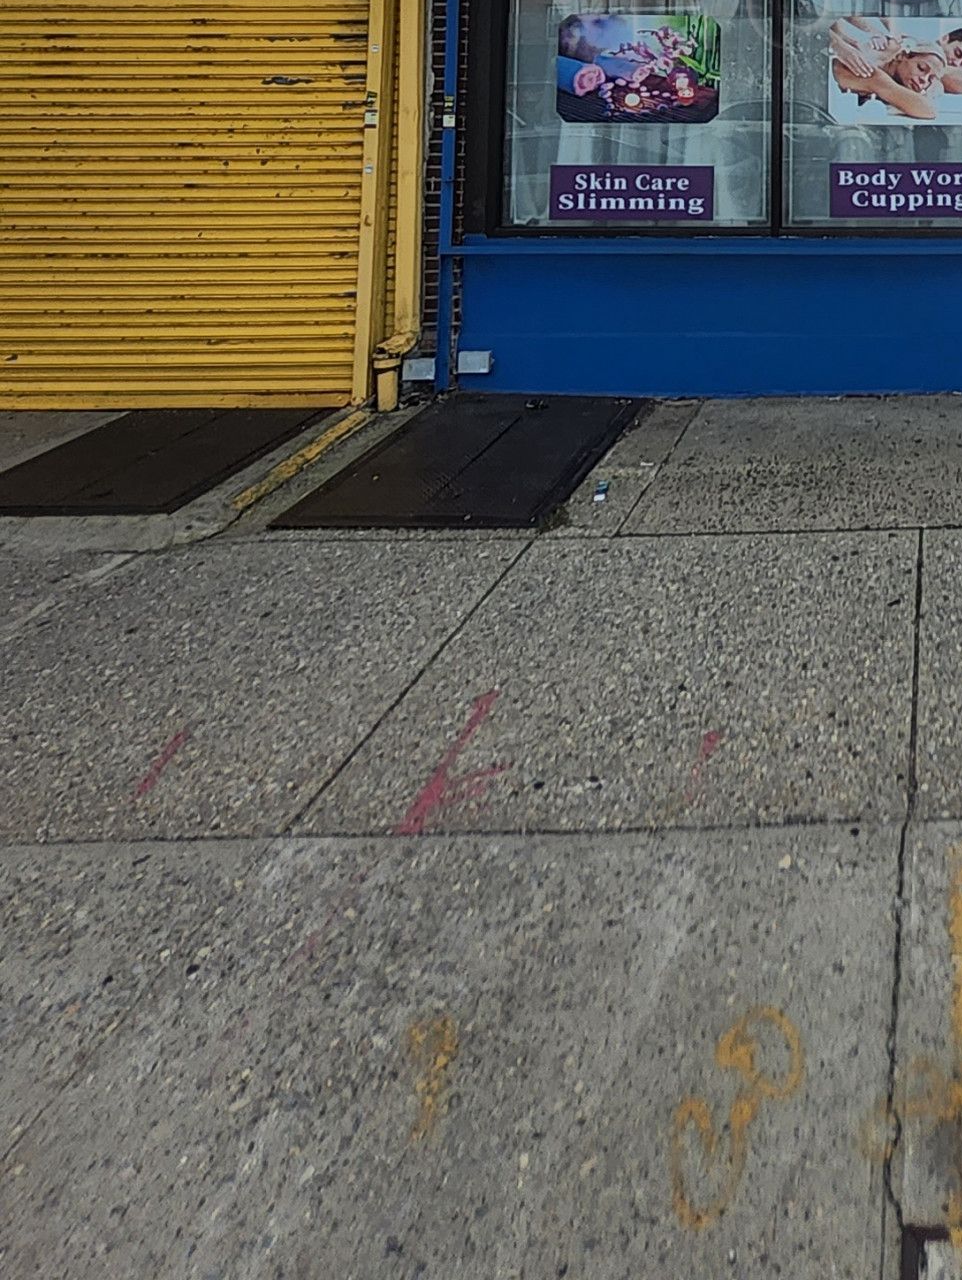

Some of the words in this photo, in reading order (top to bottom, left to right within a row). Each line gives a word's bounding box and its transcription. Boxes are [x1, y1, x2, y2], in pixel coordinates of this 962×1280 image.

[574, 173, 628, 191] Skin
[635, 173, 690, 191] Care
[838, 169, 902, 190] Body
[558, 193, 705, 215] Slimming
